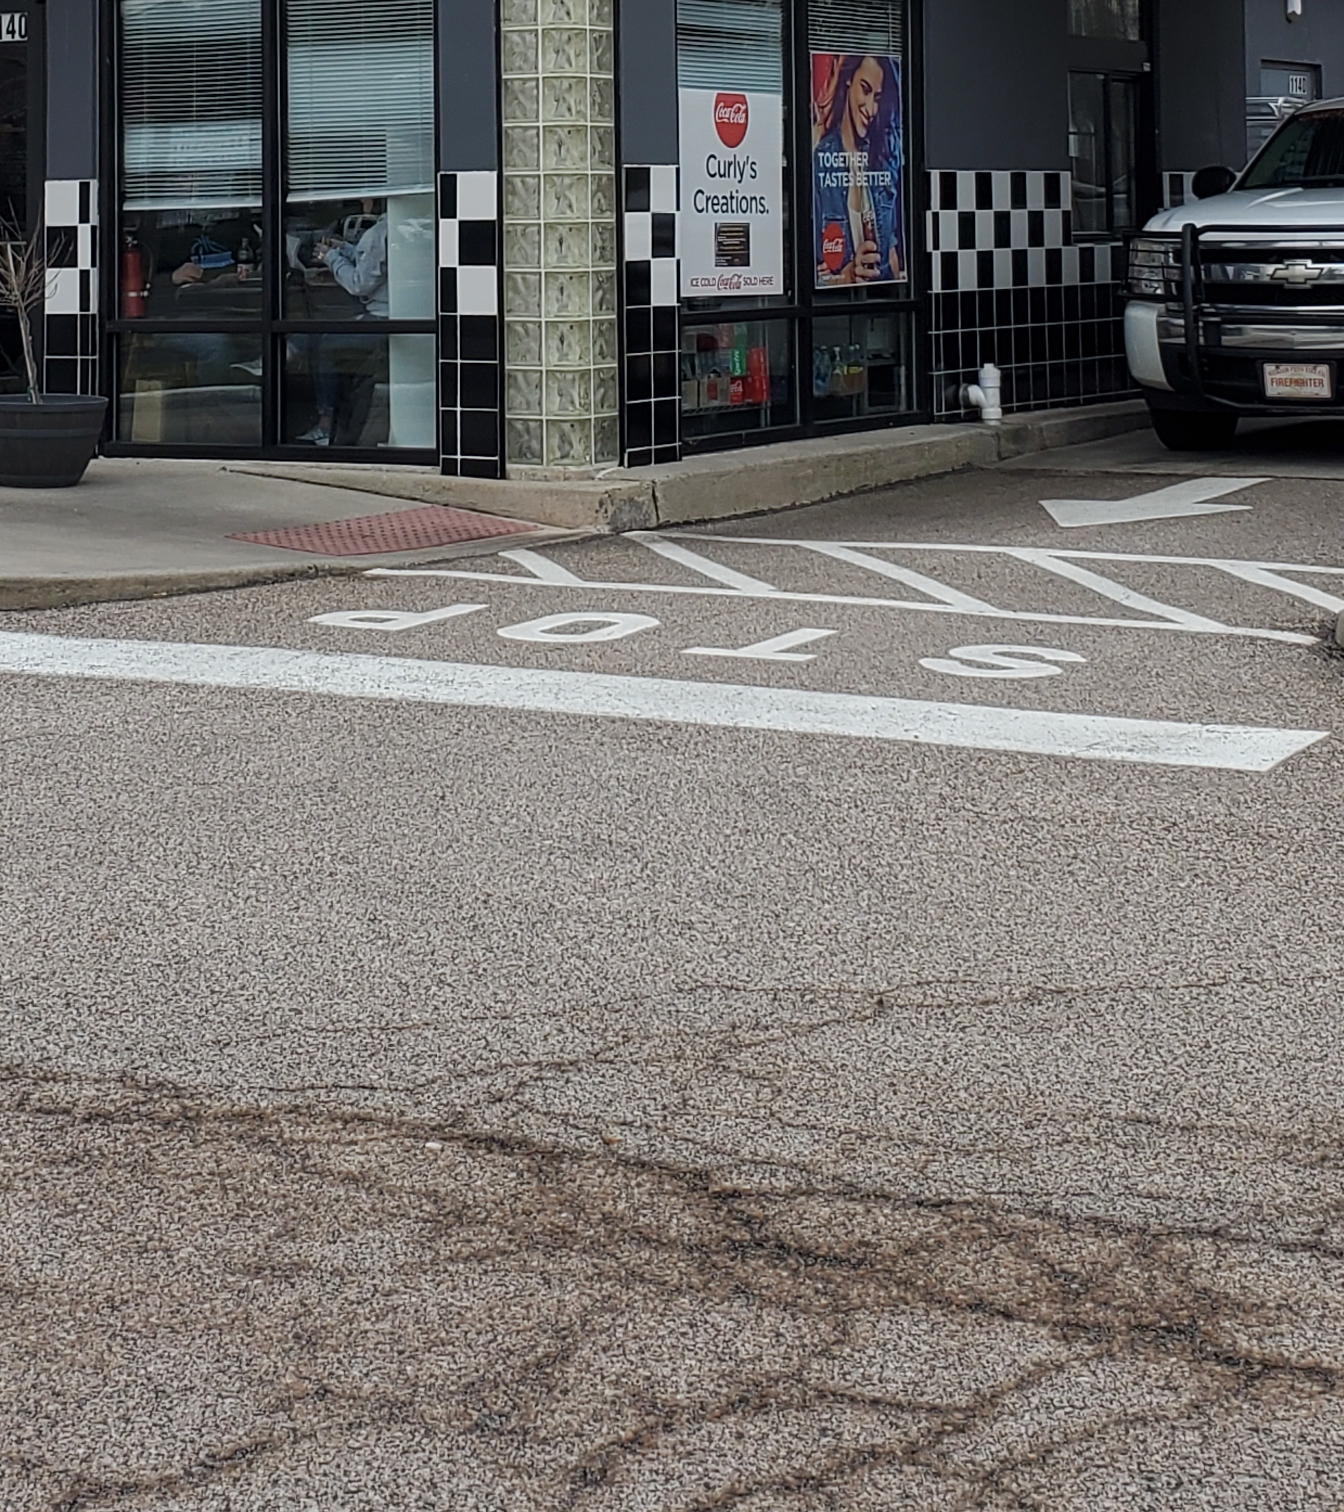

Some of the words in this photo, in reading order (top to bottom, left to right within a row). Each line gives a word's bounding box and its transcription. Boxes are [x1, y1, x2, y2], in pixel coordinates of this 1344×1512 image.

[817, 151, 869, 168] TOGETHER
[705, 153, 758, 184] Curly's
[818, 171, 855, 188] TASTES
[856, 171, 892, 187] BETTER
[693, 188, 770, 215] Creations.
[700, 277, 716, 287] COLD
[743, 276, 757, 287] SOLD
[759, 276, 774, 286] HERE
[1270, 377, 1324, 388] FIREFIGHTER
[306, 603, 1087, 679] STOP
